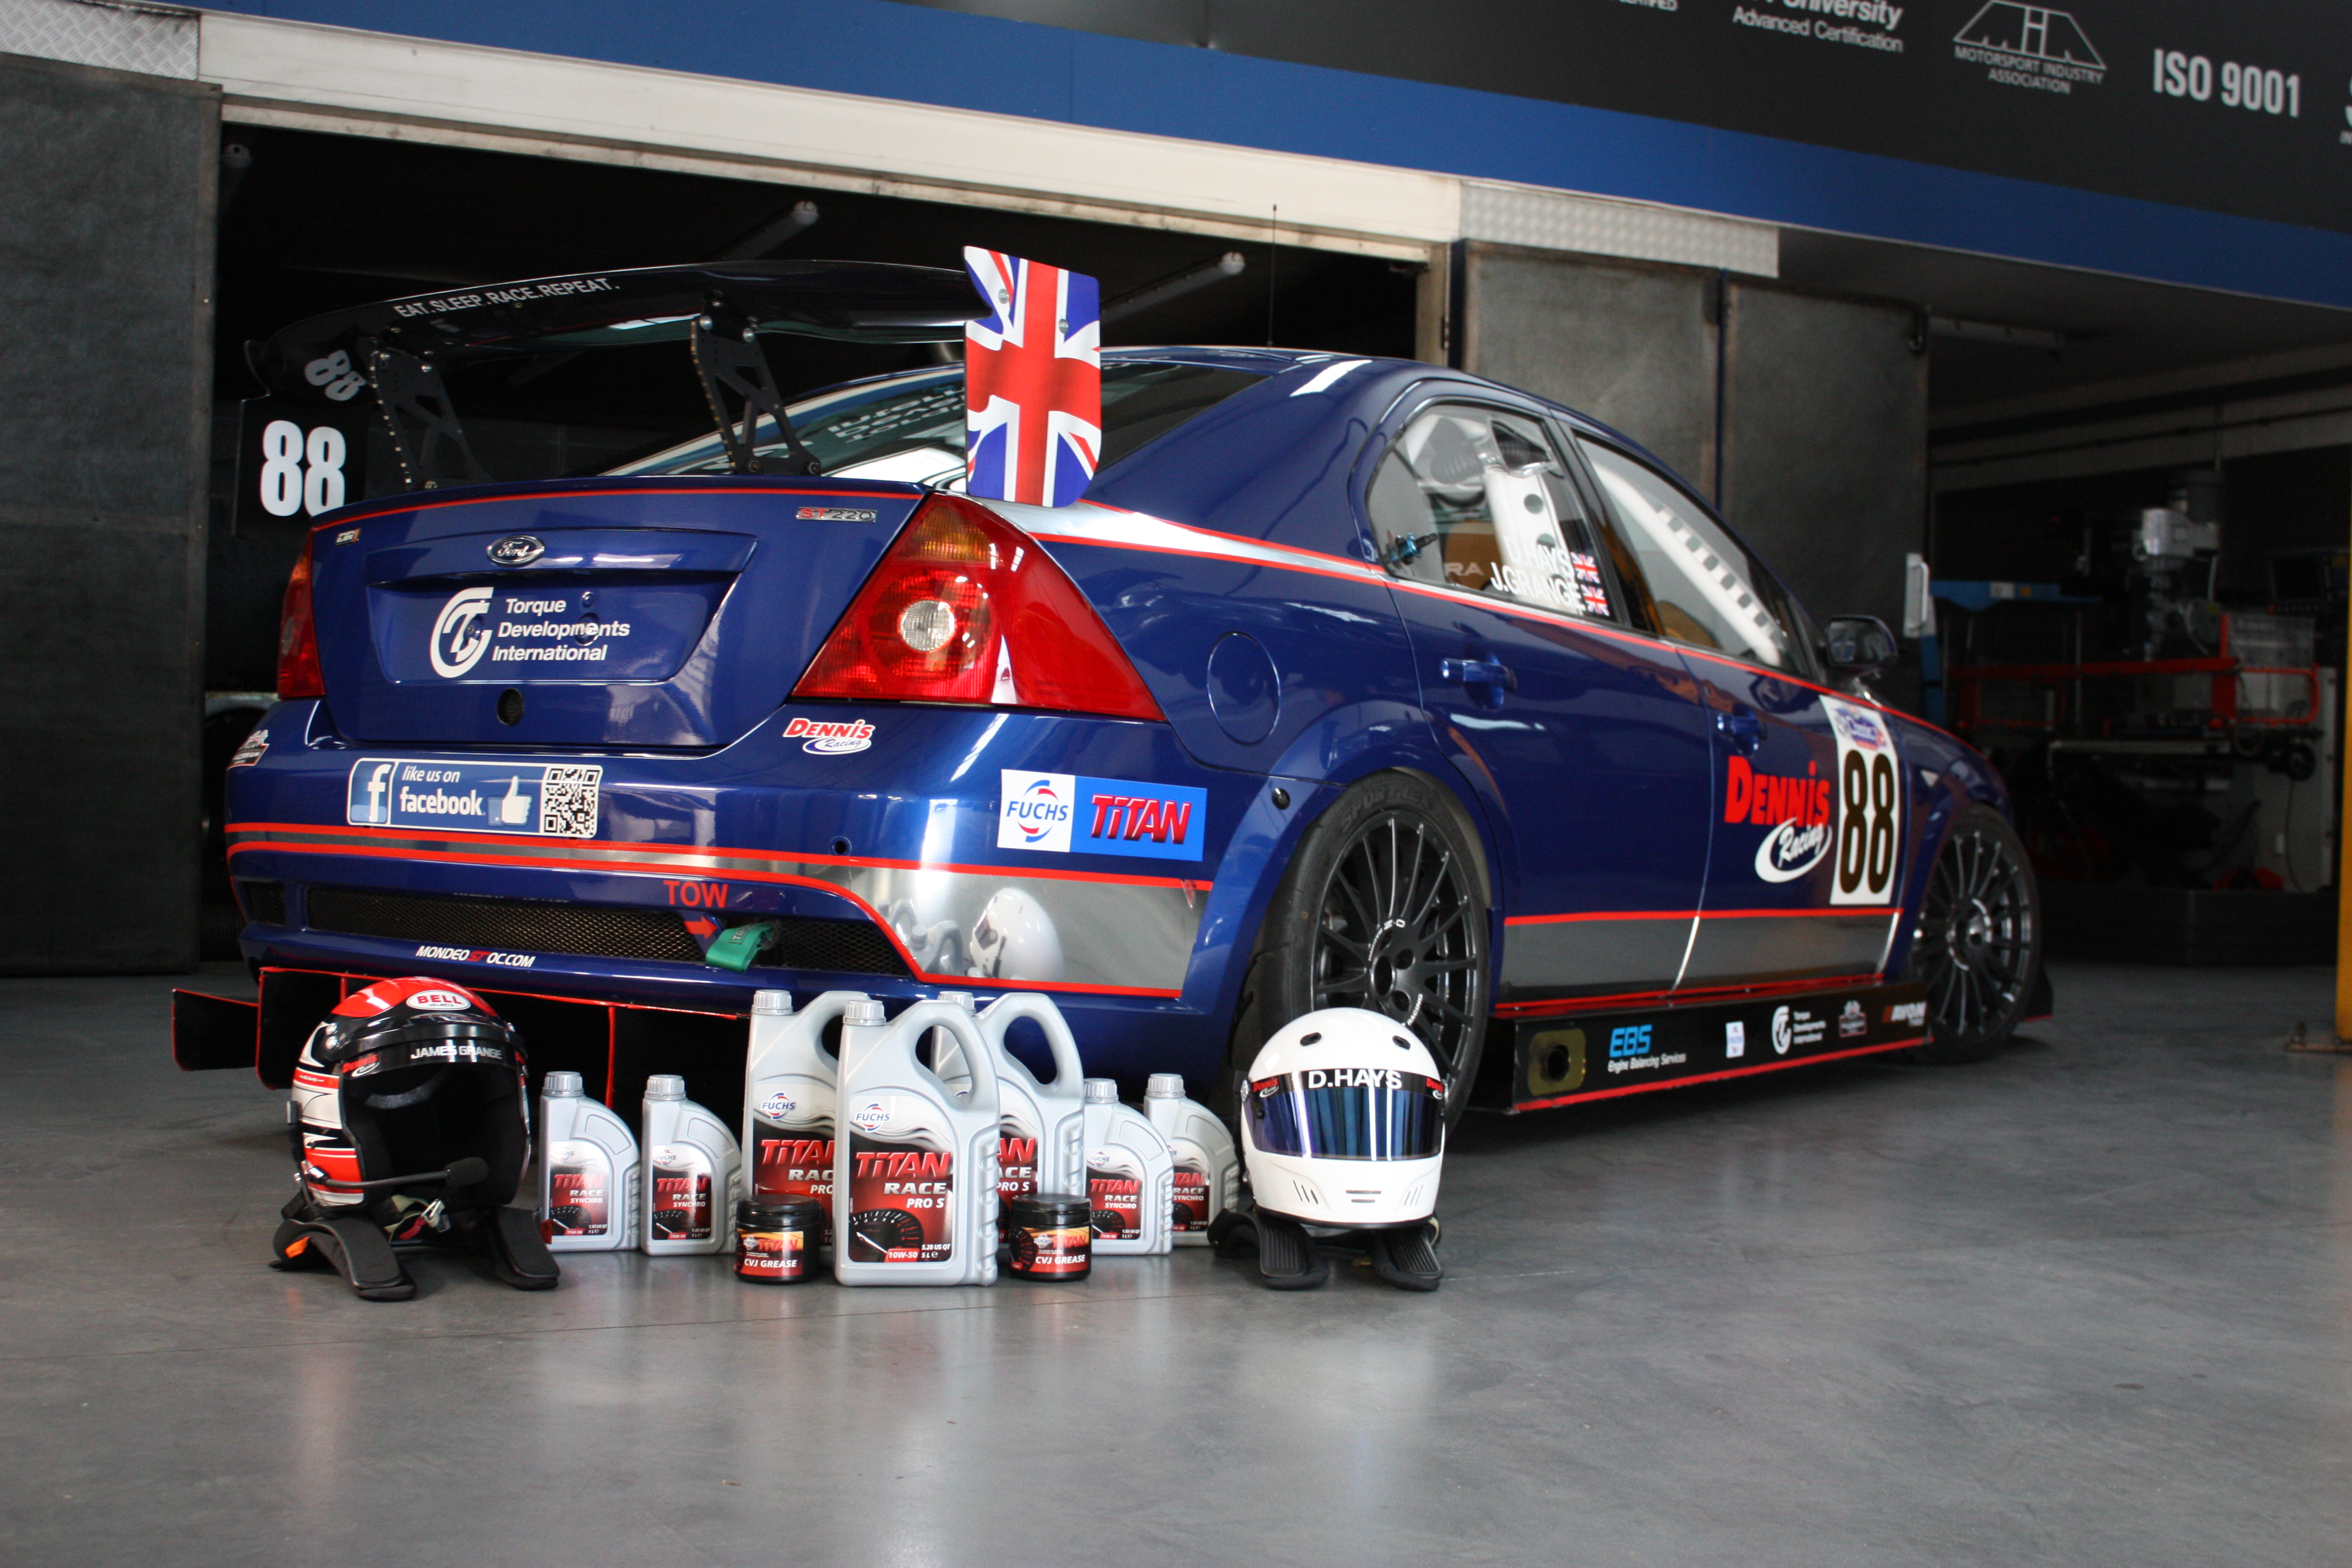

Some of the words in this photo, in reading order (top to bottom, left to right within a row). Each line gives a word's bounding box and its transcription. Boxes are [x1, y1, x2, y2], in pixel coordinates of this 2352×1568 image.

[1733, 6, 1811, 36] Advanced
[1815, 20, 1904, 53] Certification
[1955, 45, 2039, 73] MOTORSPORT
[2043, 62, 2104, 84] INDUSTRY
[1988, 67, 2071, 94] ASSOCIATION
[2153, 48, 2212, 101] ISO
[2221, 62, 2300, 117] 9001
[260, 420, 345, 516] 88
[497, 540, 529, 558] Ford
[1504, 536, 1575, 578] D.HAYS
[1490, 561, 1586, 612] J.GRANGE
[505, 598, 567, 614] Torque
[498, 621, 630, 641] Developments
[492, 645, 608, 661] International
[823, 738, 862, 749] Racing
[402, 766, 424, 782] like
[427, 770, 442, 783] us
[443, 771, 460, 783] on
[400, 786, 484, 816] facebook
[1006, 801, 1067, 822] FUCHS
[1839, 749, 1895, 894] 88
[1778, 822, 1825, 868] Racing
[664, 880, 728, 909] TOW
[416, 945, 536, 968] MONDEOSTOC.COM
[417, 995, 462, 1004] BELL
[1407, 993, 1423, 1026] RACING
[1609, 1024, 1653, 1058] EBS
[410, 1046, 457, 1059] JAMES
[459, 1046, 503, 1059] GRANGE
[1308, 1069, 1403, 1090] D.HAYS
[761, 1102, 796, 1110] FUCHS
[788, 1169, 833, 1181] RAC
[1174, 1173, 1207, 1186] TAN
[884, 1183, 948, 1195] RACE
[1022, 1182, 1030, 1191] S
[906, 1198, 933, 1208] PRO
[936, 1197, 945, 1208] S
[744, 1259, 758, 1267] CVJ
[760, 1259, 798, 1268] GREASE
[1035, 1256, 1052, 1264] CVJ
[1054, 1254, 1086, 1264] GREASE
